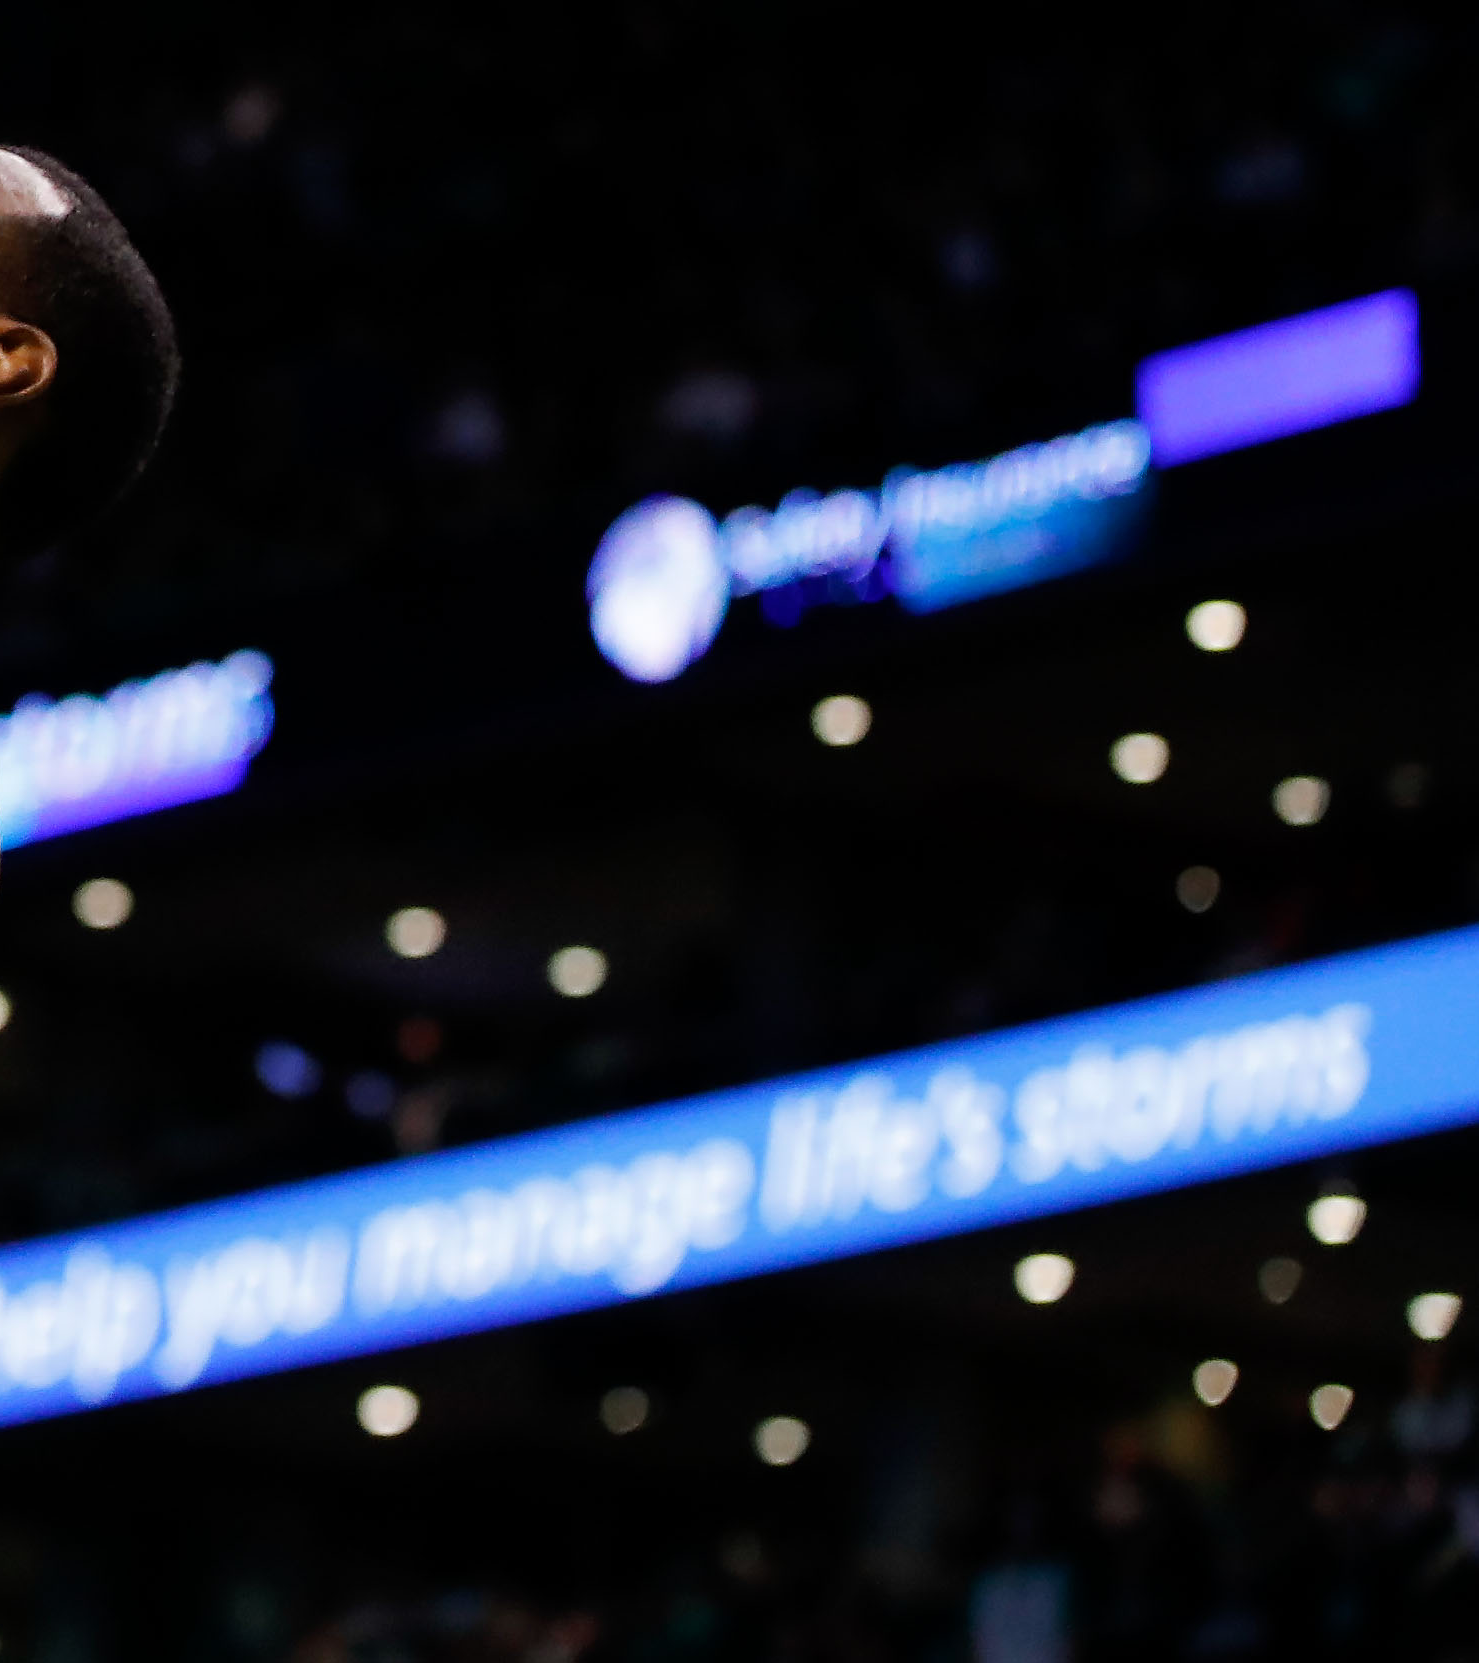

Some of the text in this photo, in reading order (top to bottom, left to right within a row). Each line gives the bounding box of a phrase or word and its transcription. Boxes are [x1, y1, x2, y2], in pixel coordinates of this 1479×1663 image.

[157, 1225, 350, 1389] you
[354, 1137, 755, 1316] manage
[760, 1066, 1006, 1234] life's
[1009, 1002, 1373, 1184] storms
